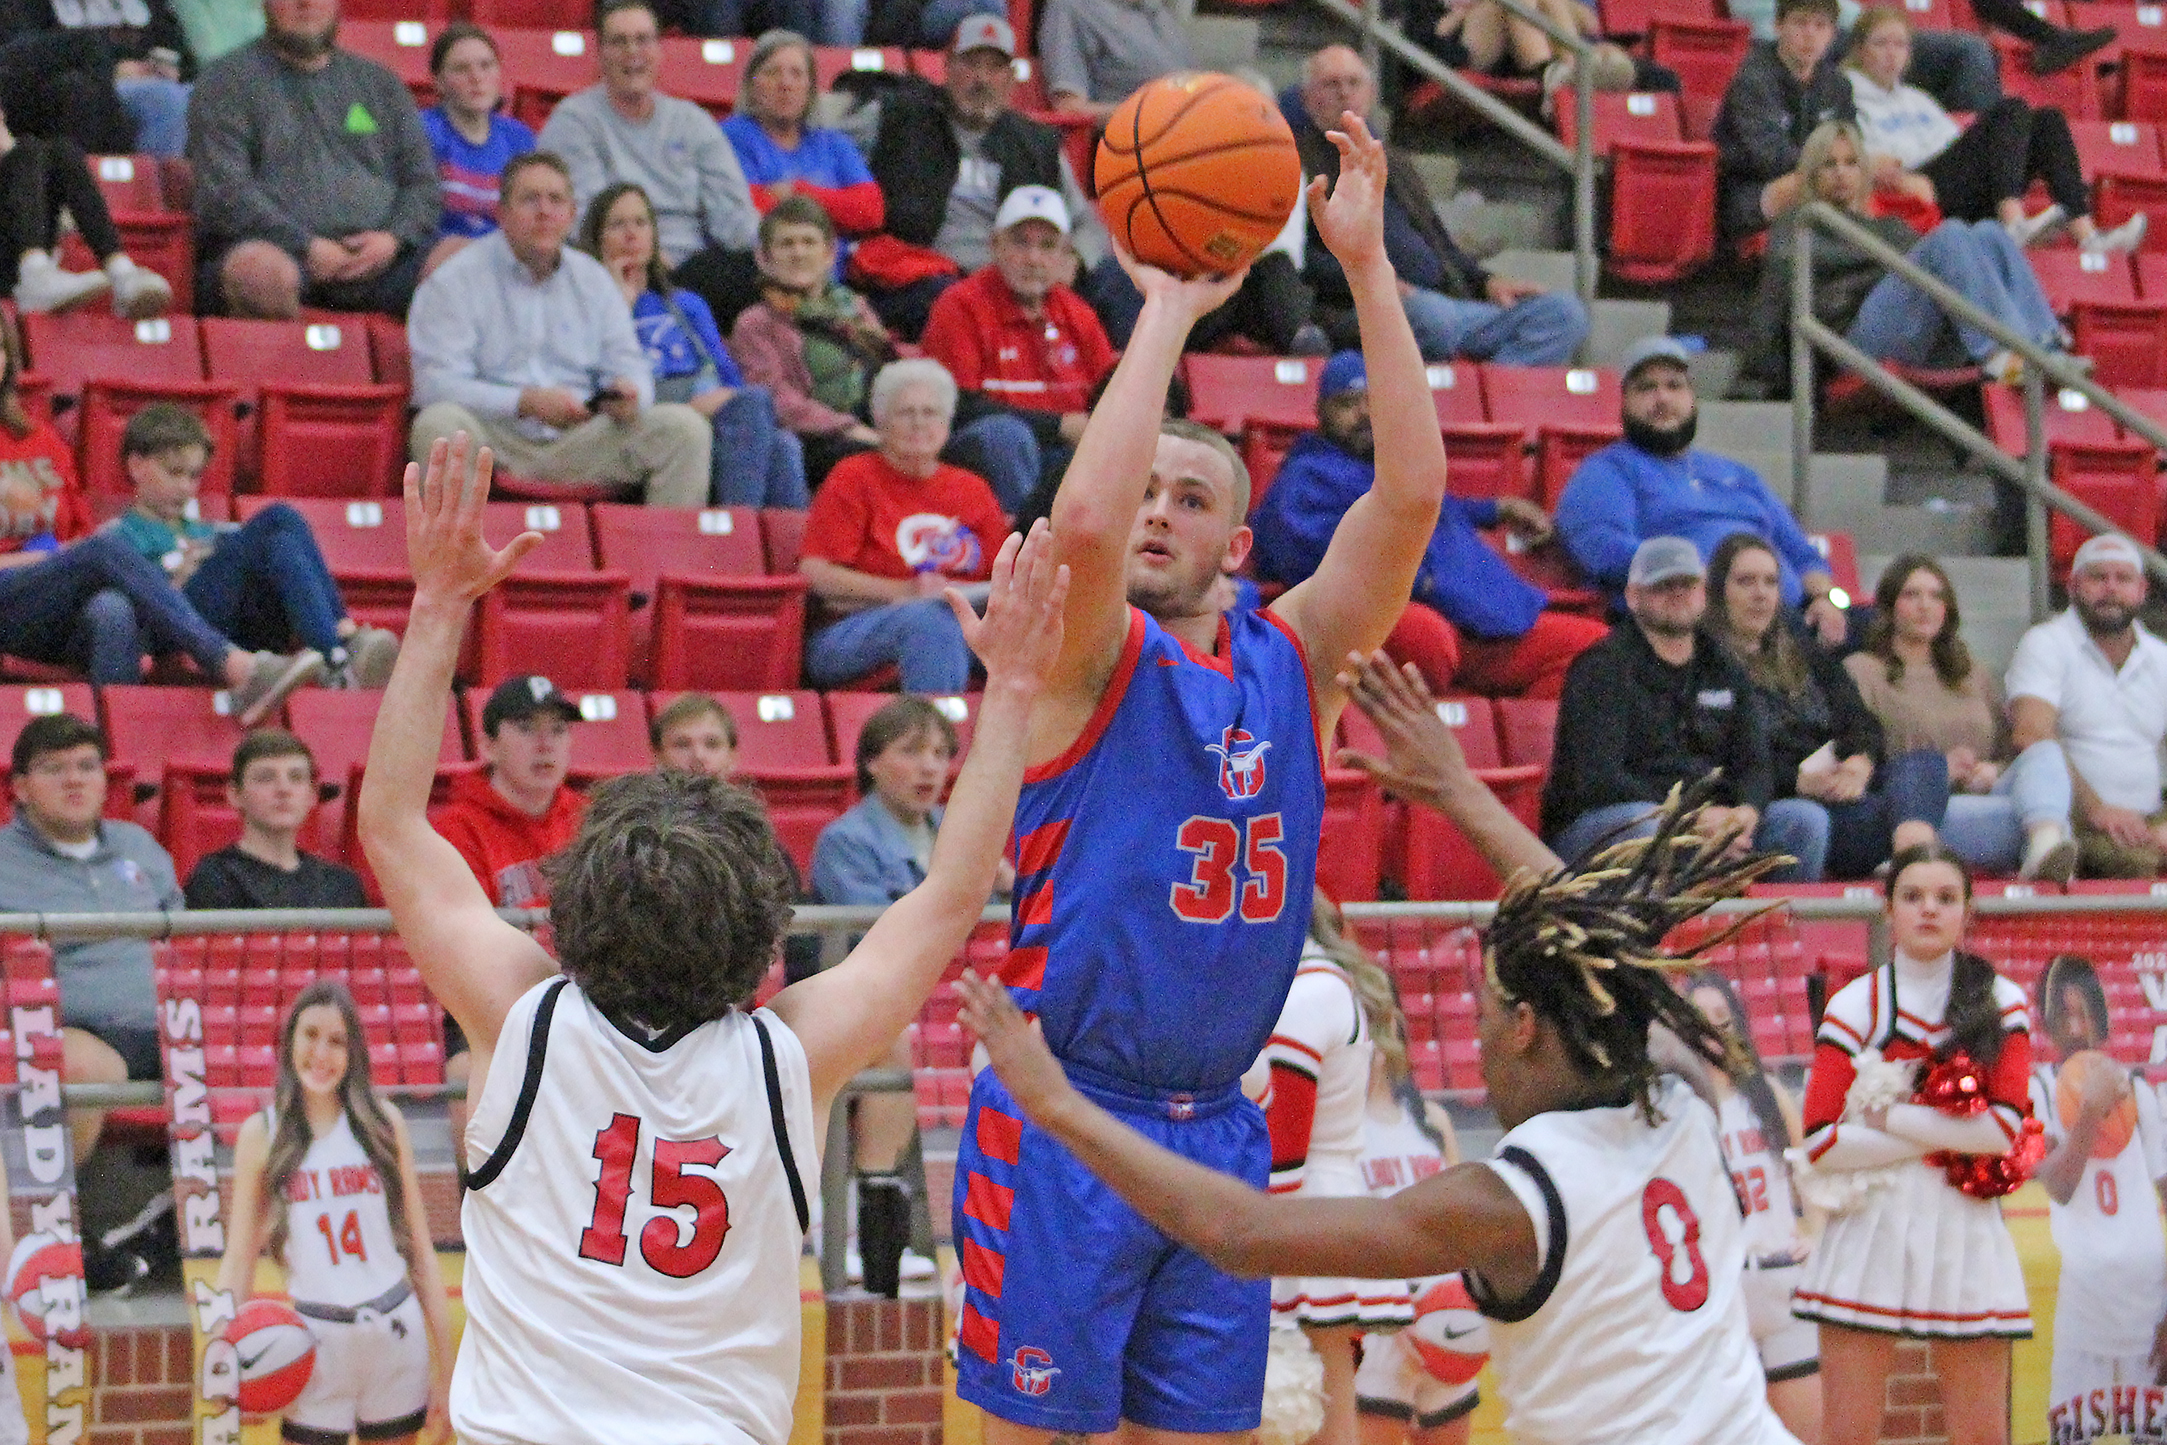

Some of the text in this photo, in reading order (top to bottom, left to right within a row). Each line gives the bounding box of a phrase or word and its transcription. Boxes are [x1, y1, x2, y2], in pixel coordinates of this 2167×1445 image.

[1169, 812, 1288, 924] 35
[12, 1005, 75, 1244] LADY
[165, 997, 225, 1252] RAMS
[316, 1209, 368, 1266] 14
[578, 1112, 734, 1278] 15
[1642, 1176, 1710, 1312] 0
[2095, 1170, 2119, 1217] 0
